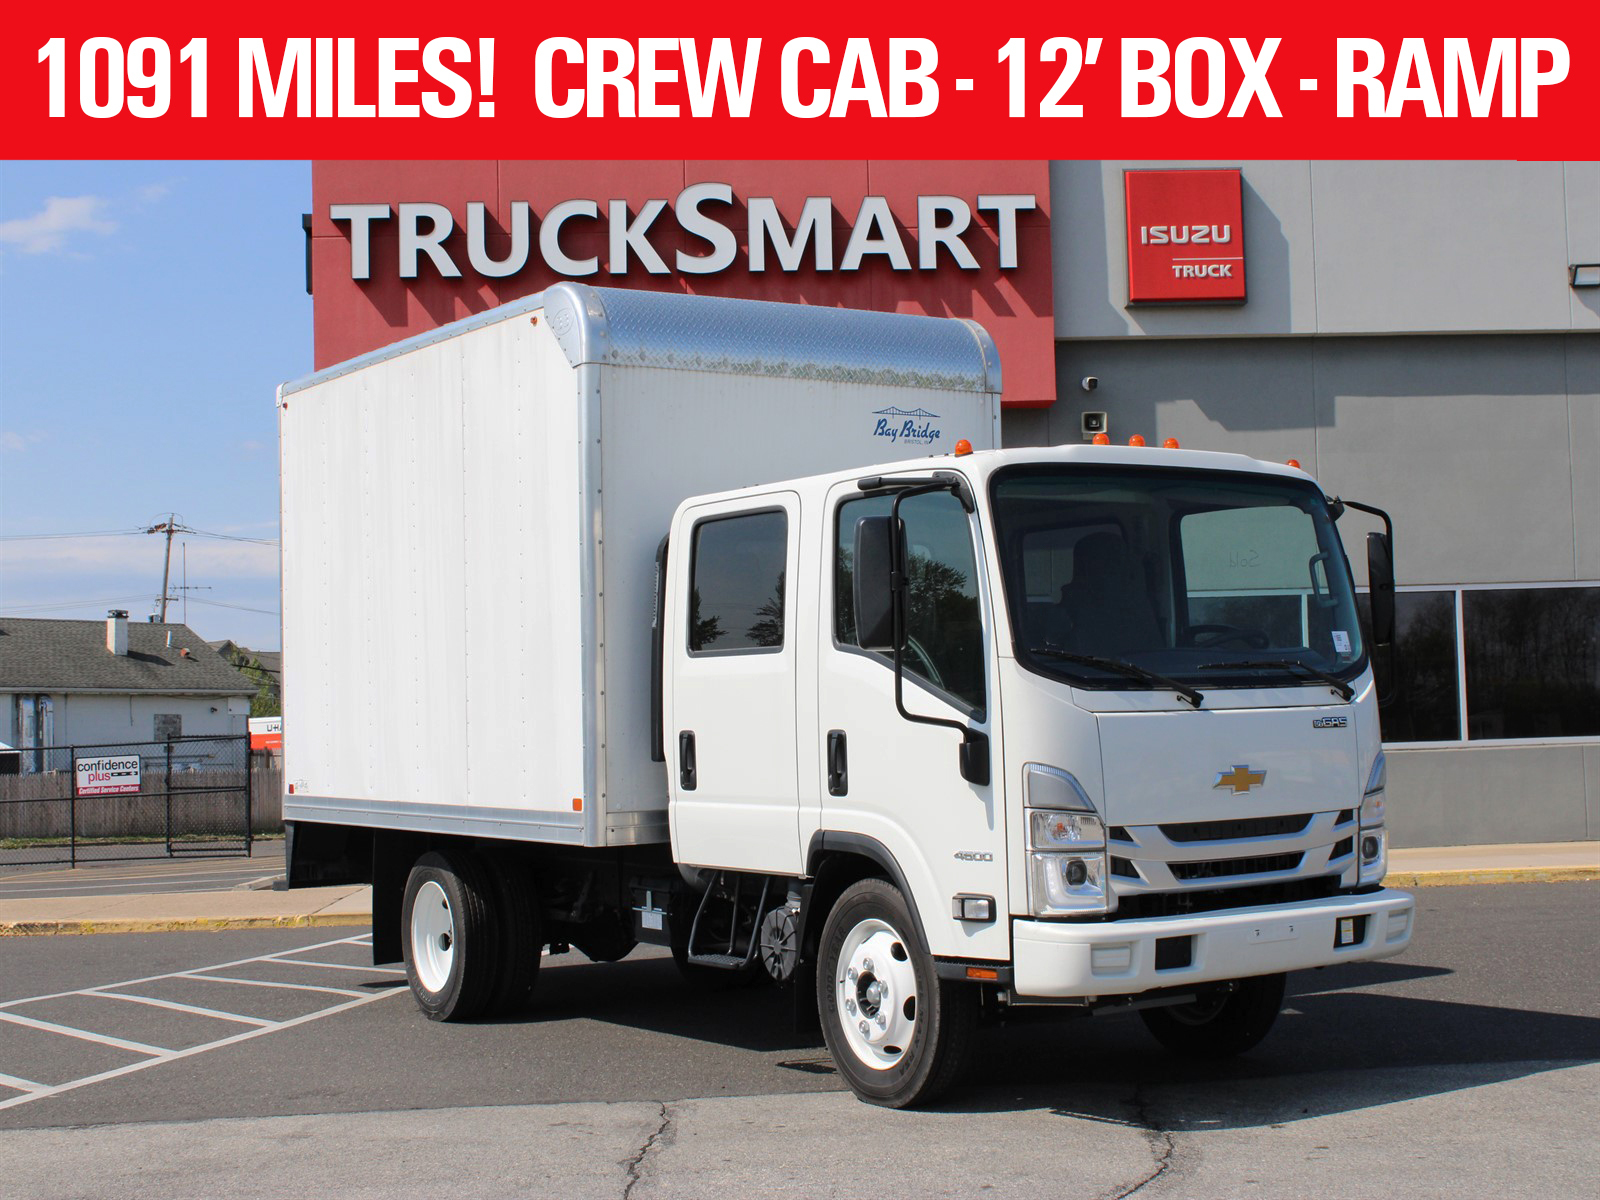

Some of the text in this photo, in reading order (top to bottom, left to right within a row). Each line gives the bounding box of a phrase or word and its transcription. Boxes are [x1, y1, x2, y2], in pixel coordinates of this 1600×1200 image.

[1140, 225, 1231, 245] ISUZU
[1172, 264, 1232, 279] TRUCK
[873, 418, 941, 444] Bay Bridge
[77, 759, 138, 772] confidence
[88, 771, 111, 785] plus
[79, 787, 100, 795] Certified
[953, 850, 994, 862] 4500
